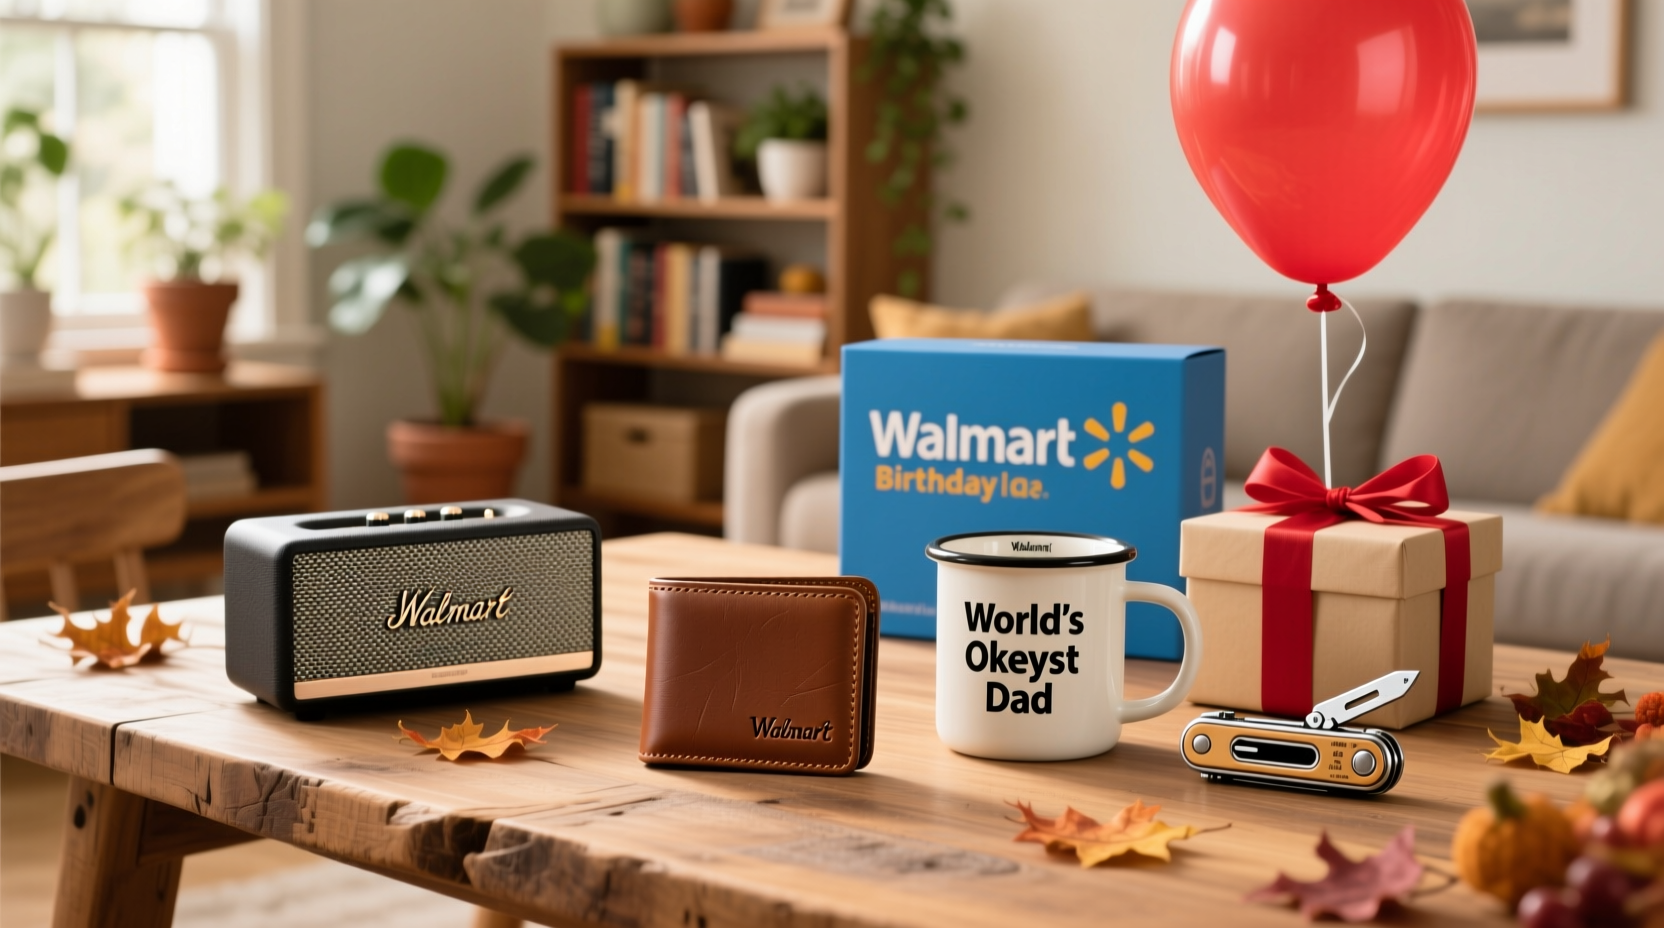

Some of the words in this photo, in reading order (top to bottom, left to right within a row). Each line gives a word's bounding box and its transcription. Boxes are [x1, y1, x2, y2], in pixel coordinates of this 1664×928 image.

[869, 409, 1076, 467] Walmart
[875, 464, 998, 503] Birthday
[387, 585, 514, 630] Walmart
[964, 601, 1085, 636] World's
[965, 640, 1079, 683] Okeyst
[986, 681, 1052, 714] Dad
[750, 716, 834, 742] Walmart
